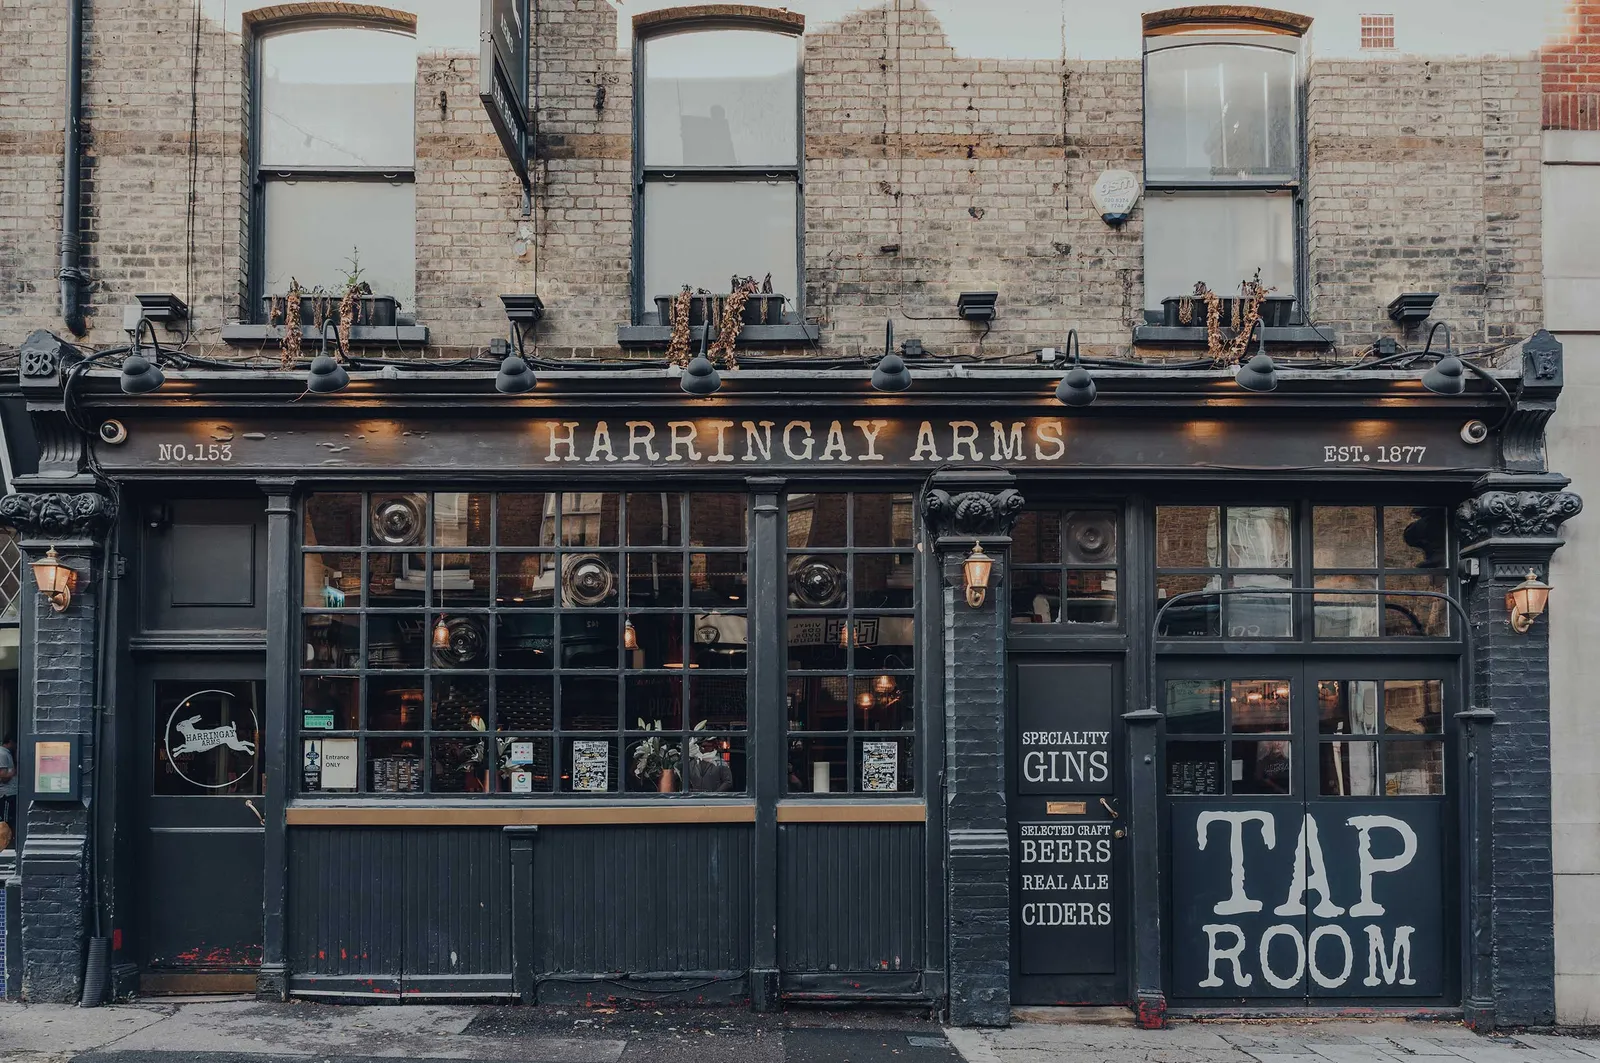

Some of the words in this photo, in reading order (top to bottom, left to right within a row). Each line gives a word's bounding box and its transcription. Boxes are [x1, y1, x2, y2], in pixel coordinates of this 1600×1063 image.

[544, 419, 888, 464] HARRINGAY
[909, 420, 1066, 463] ARMS
[158, 443, 233, 462] NO.153
[1323, 445, 1370, 463] EST.
[1377, 445, 1427, 463] 1877
[186, 729, 236, 742] HARRINGAY
[1022, 731, 1110, 745] SPECIALITY
[1023, 751, 1109, 783] GINS
[1021, 825, 1075, 836] SELECTED
[1077, 825, 1111, 836] CRAFT
[1021, 839, 1111, 863] BEERS
[1196, 810, 1418, 919] TAP
[1022, 874, 1068, 890] REAL
[1071, 874, 1109, 890] ALE
[1022, 902, 1111, 926] CIDERS
[1198, 923, 1417, 990] ROOM
